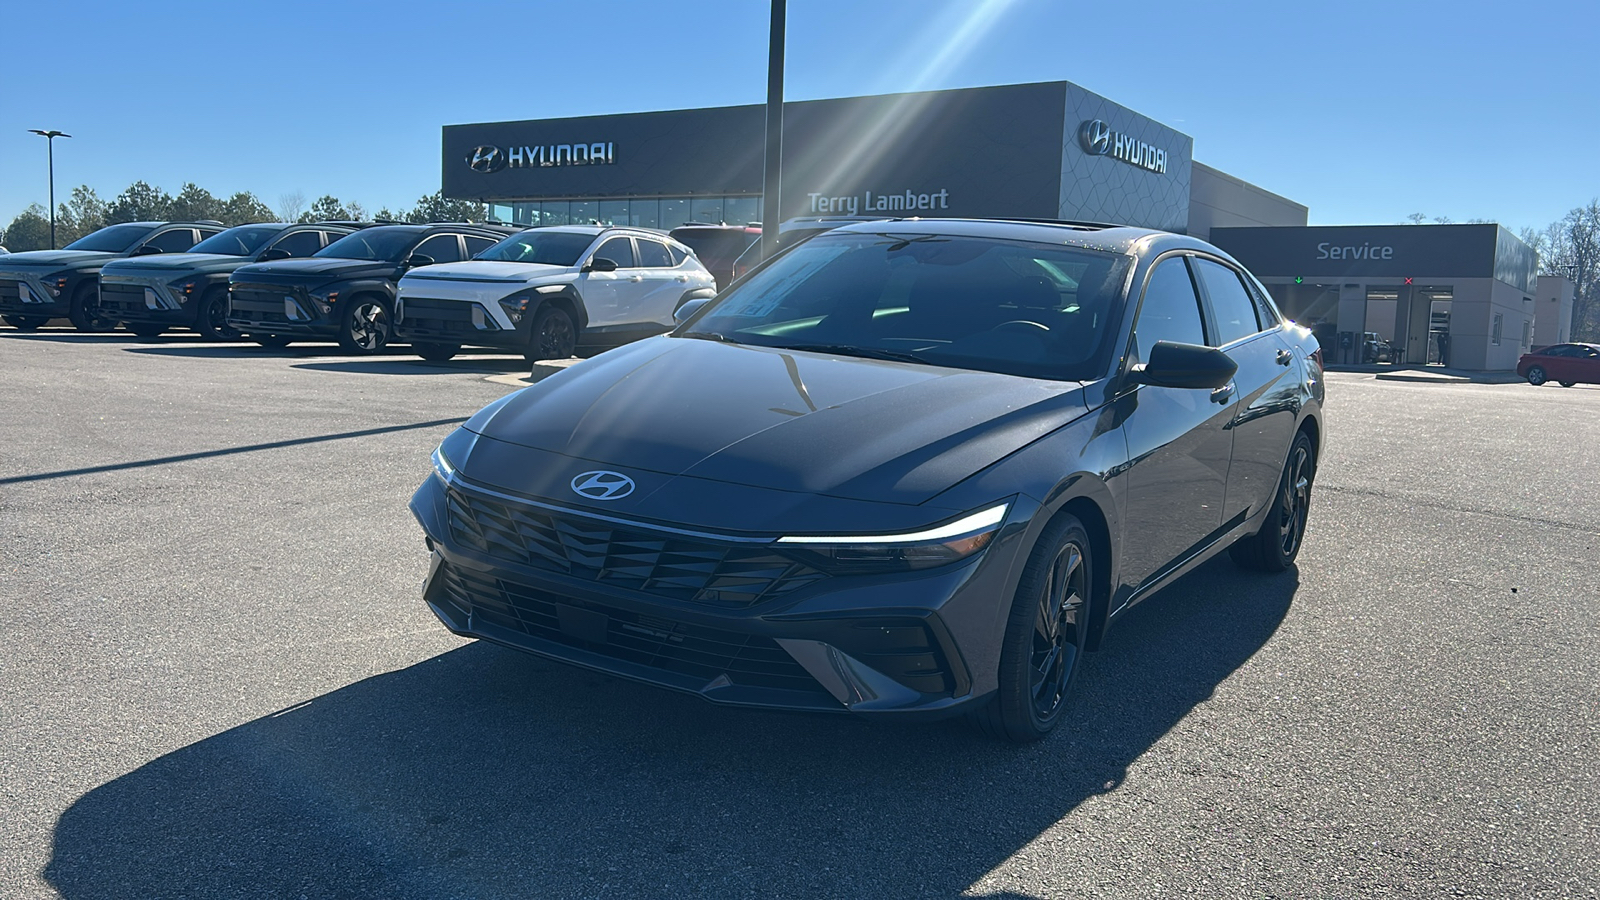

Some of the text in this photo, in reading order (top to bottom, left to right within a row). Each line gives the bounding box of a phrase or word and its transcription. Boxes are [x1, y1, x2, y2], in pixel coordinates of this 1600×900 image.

[508, 142, 613, 168] HYUNDAI
[1113, 132, 1168, 174] HYUNDAI
[807, 188, 949, 216] Terry Lambert
[1316, 242, 1393, 260] Service
